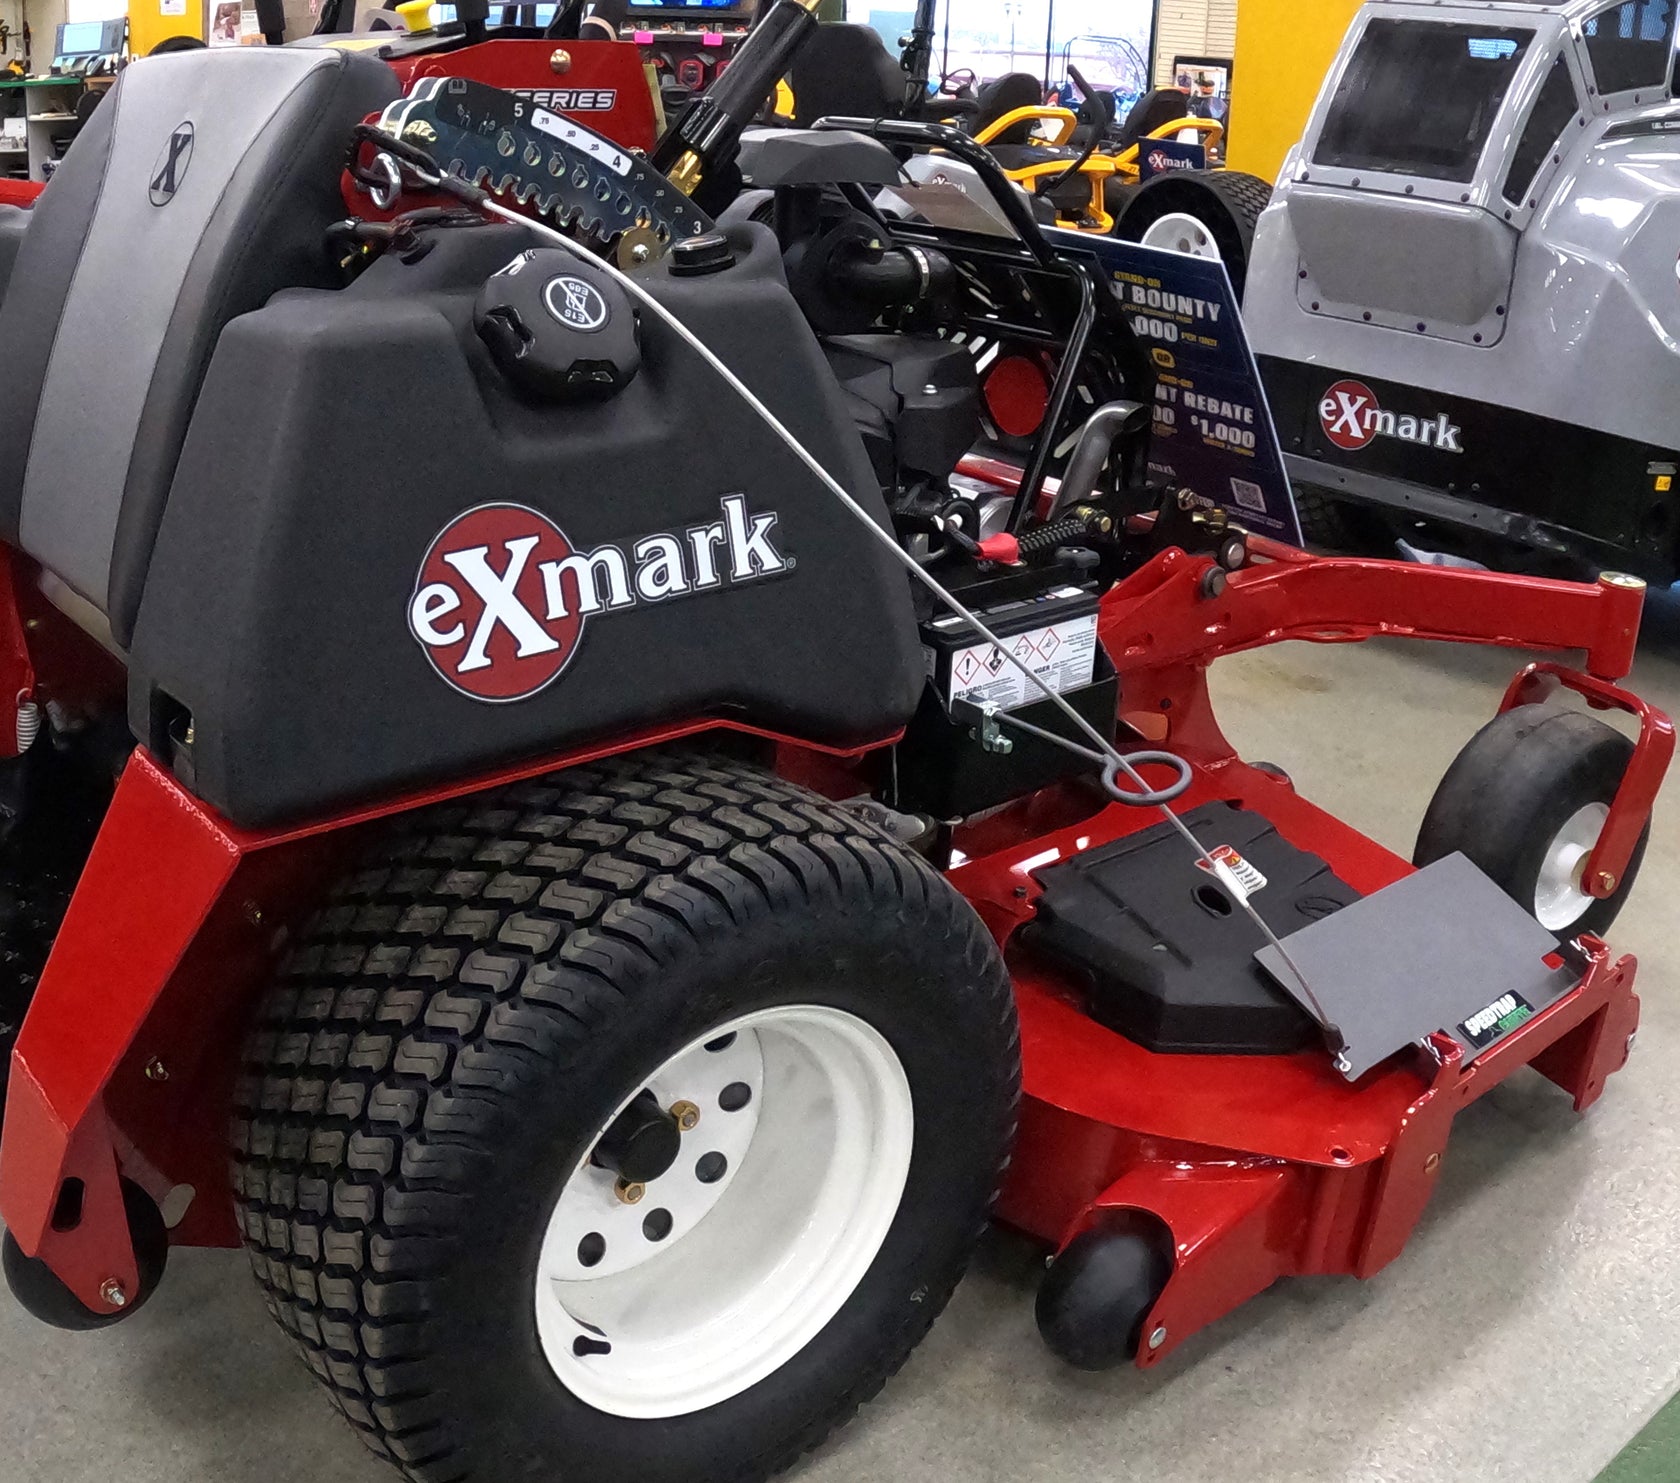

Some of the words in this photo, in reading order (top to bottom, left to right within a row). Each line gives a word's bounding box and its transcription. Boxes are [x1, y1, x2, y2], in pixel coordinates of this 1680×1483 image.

[513, 102, 524, 118] 5
[612, 154, 622, 169] 4
[693, 220, 702, 235] 3
[1147, 153, 1194, 170] eXmark
[1131, 285, 1221, 322] BOUNTY
[1183, 391, 1254, 424] REBATE
[1319, 390, 1462, 452] eXmark
[410, 495, 786, 674] eXmark
